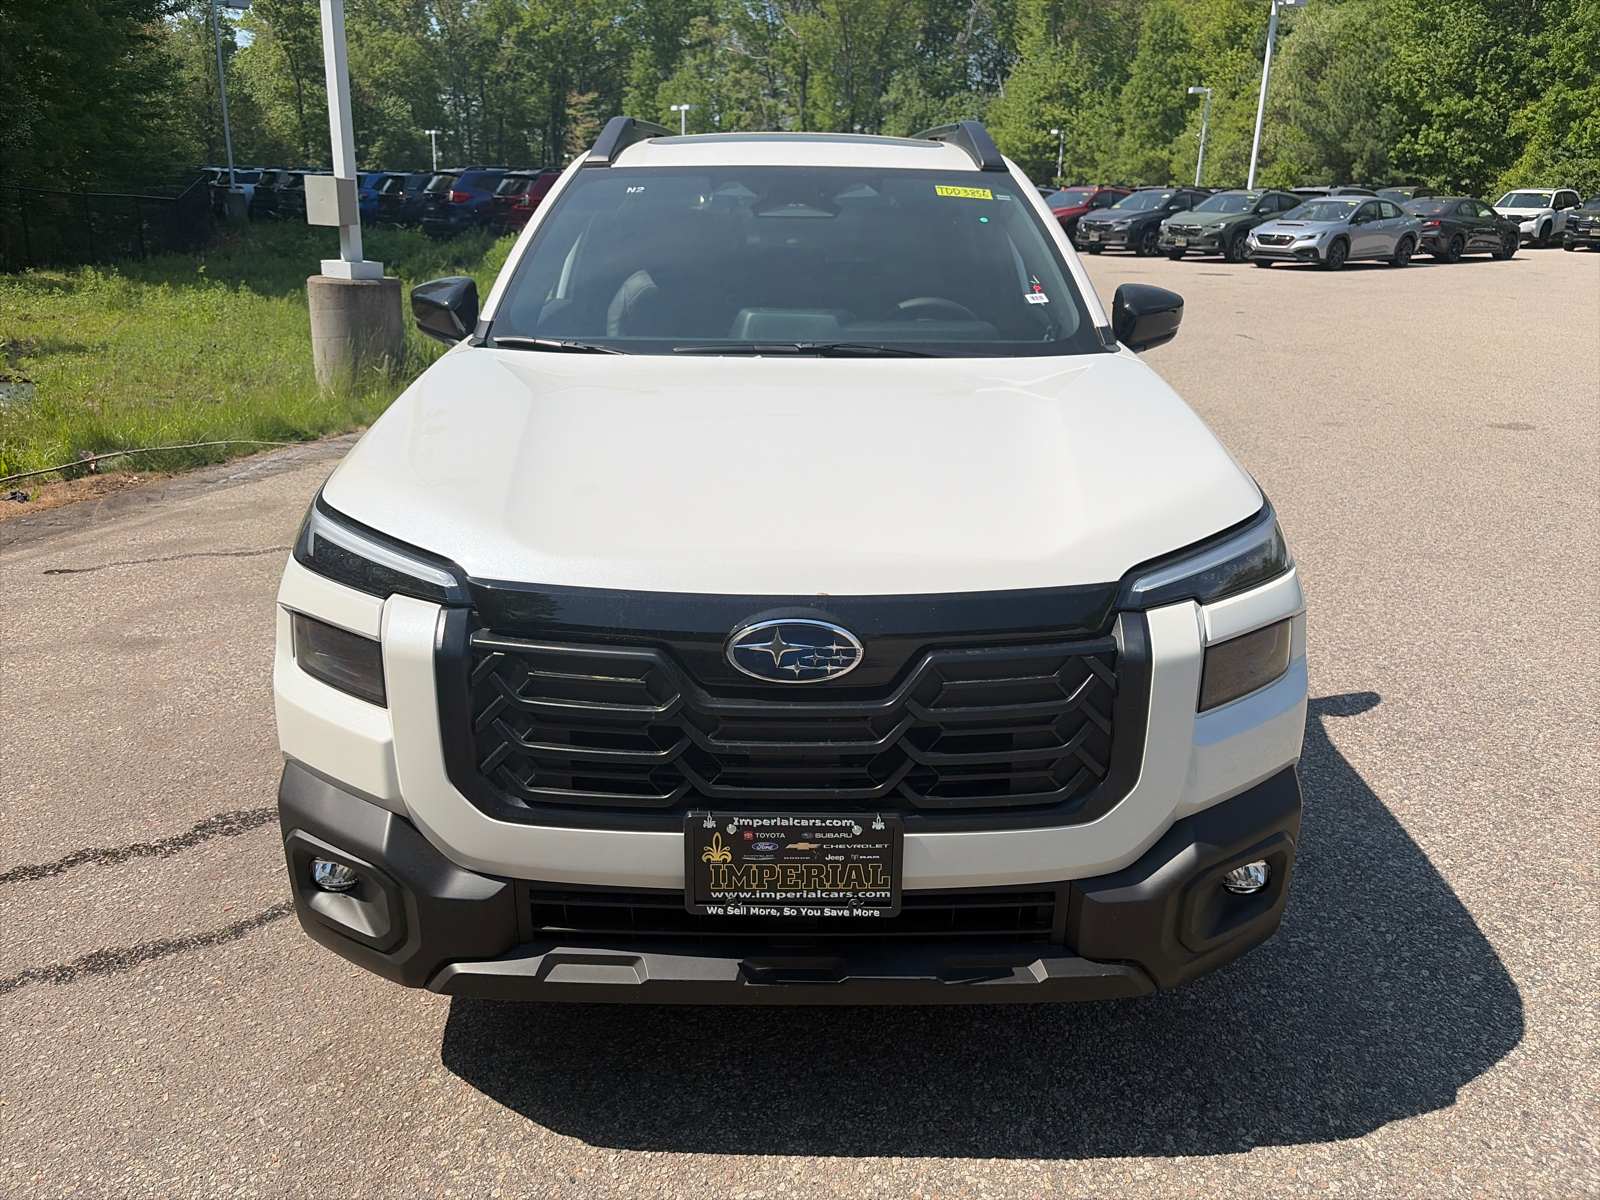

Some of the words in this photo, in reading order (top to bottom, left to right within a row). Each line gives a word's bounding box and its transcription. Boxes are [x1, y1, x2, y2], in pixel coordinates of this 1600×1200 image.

[733, 817, 855, 827] Imperialcars.com
[825, 854, 845, 862] Jeep
[710, 863, 891, 890] IMPERIAL
[710, 890, 891, 900] www.imperialcars.com
[706, 906, 724, 915] We
[727, 906, 747, 915] Sell
[750, 907, 780, 917] More,
[783, 907, 797, 916] So
[800, 907, 821, 916] You
[823, 908, 850, 917] Save
[853, 908, 880, 917] More
